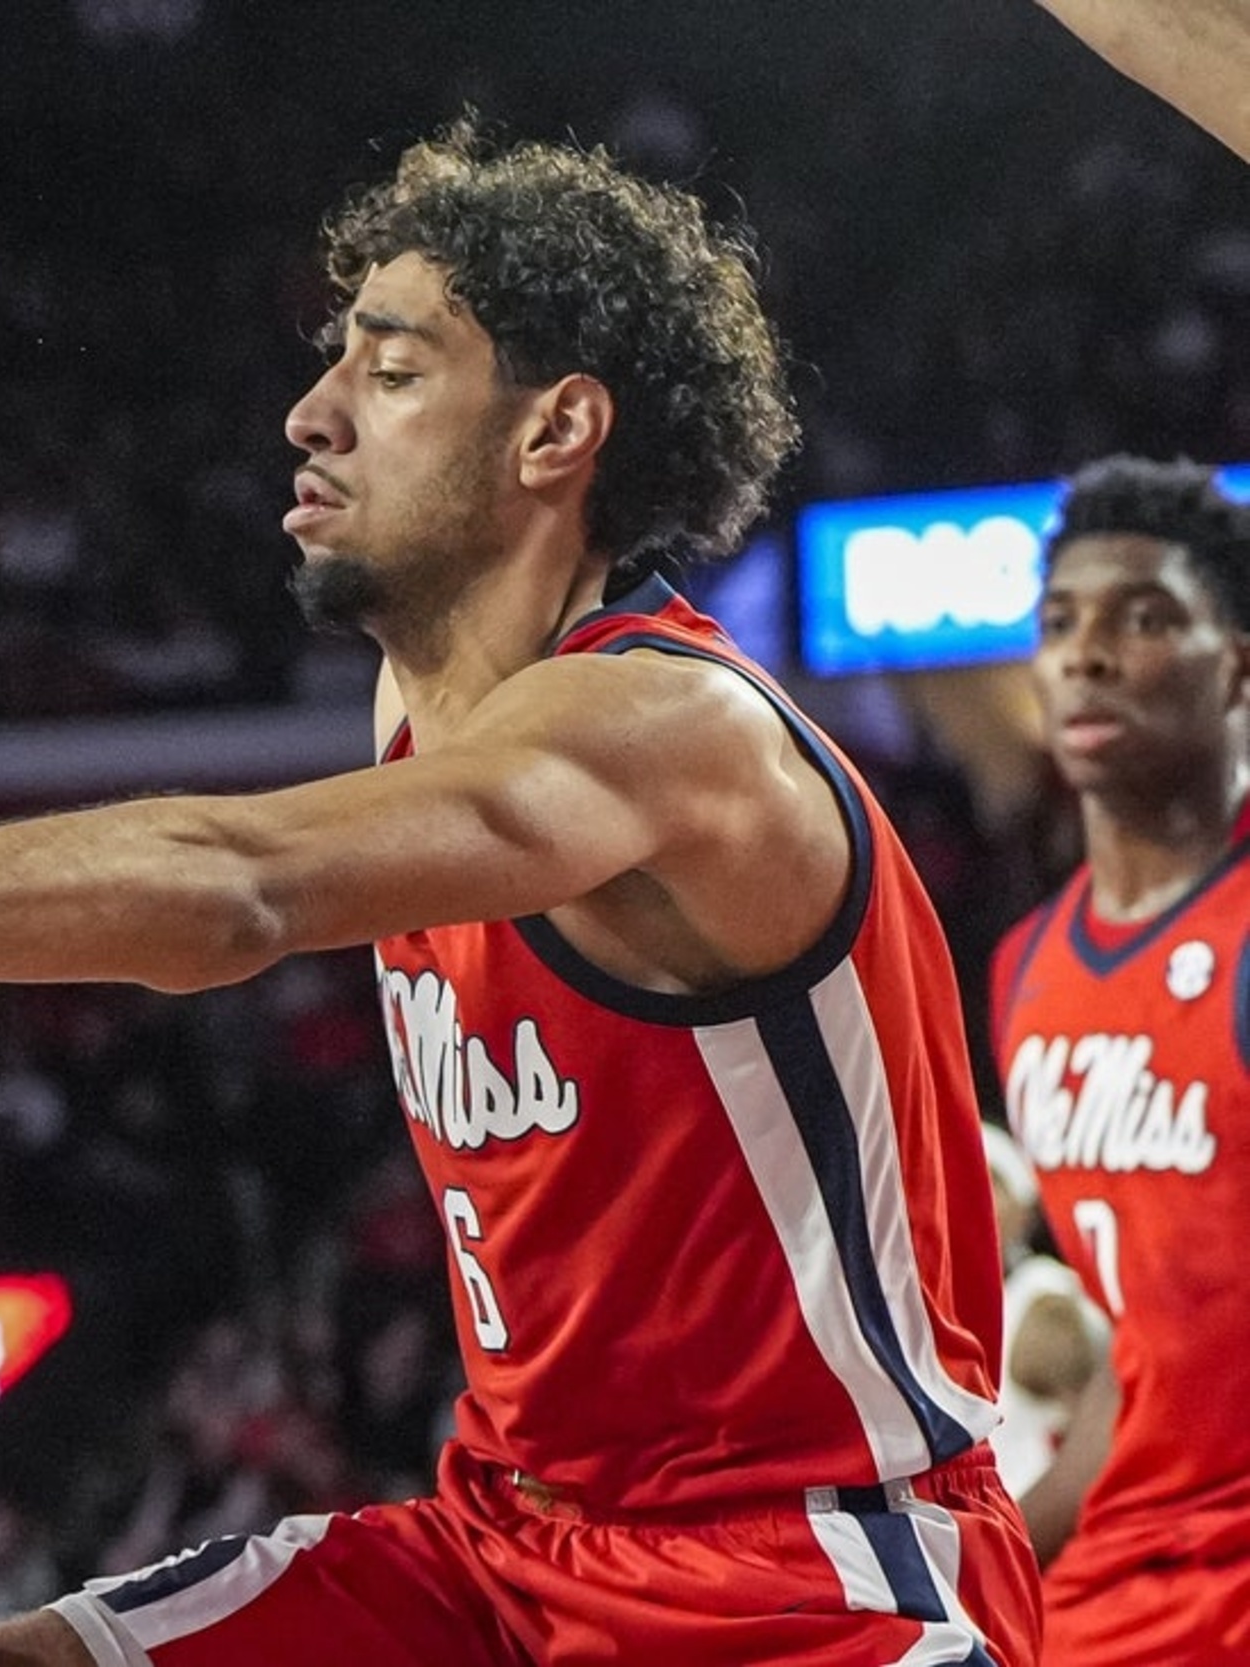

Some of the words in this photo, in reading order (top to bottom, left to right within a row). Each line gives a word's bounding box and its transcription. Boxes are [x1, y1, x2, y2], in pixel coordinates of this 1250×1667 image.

[1006, 1034, 1073, 1170] Ole
[1069, 1032, 1217, 1174] Miss
[443, 1186, 510, 1353] 6
